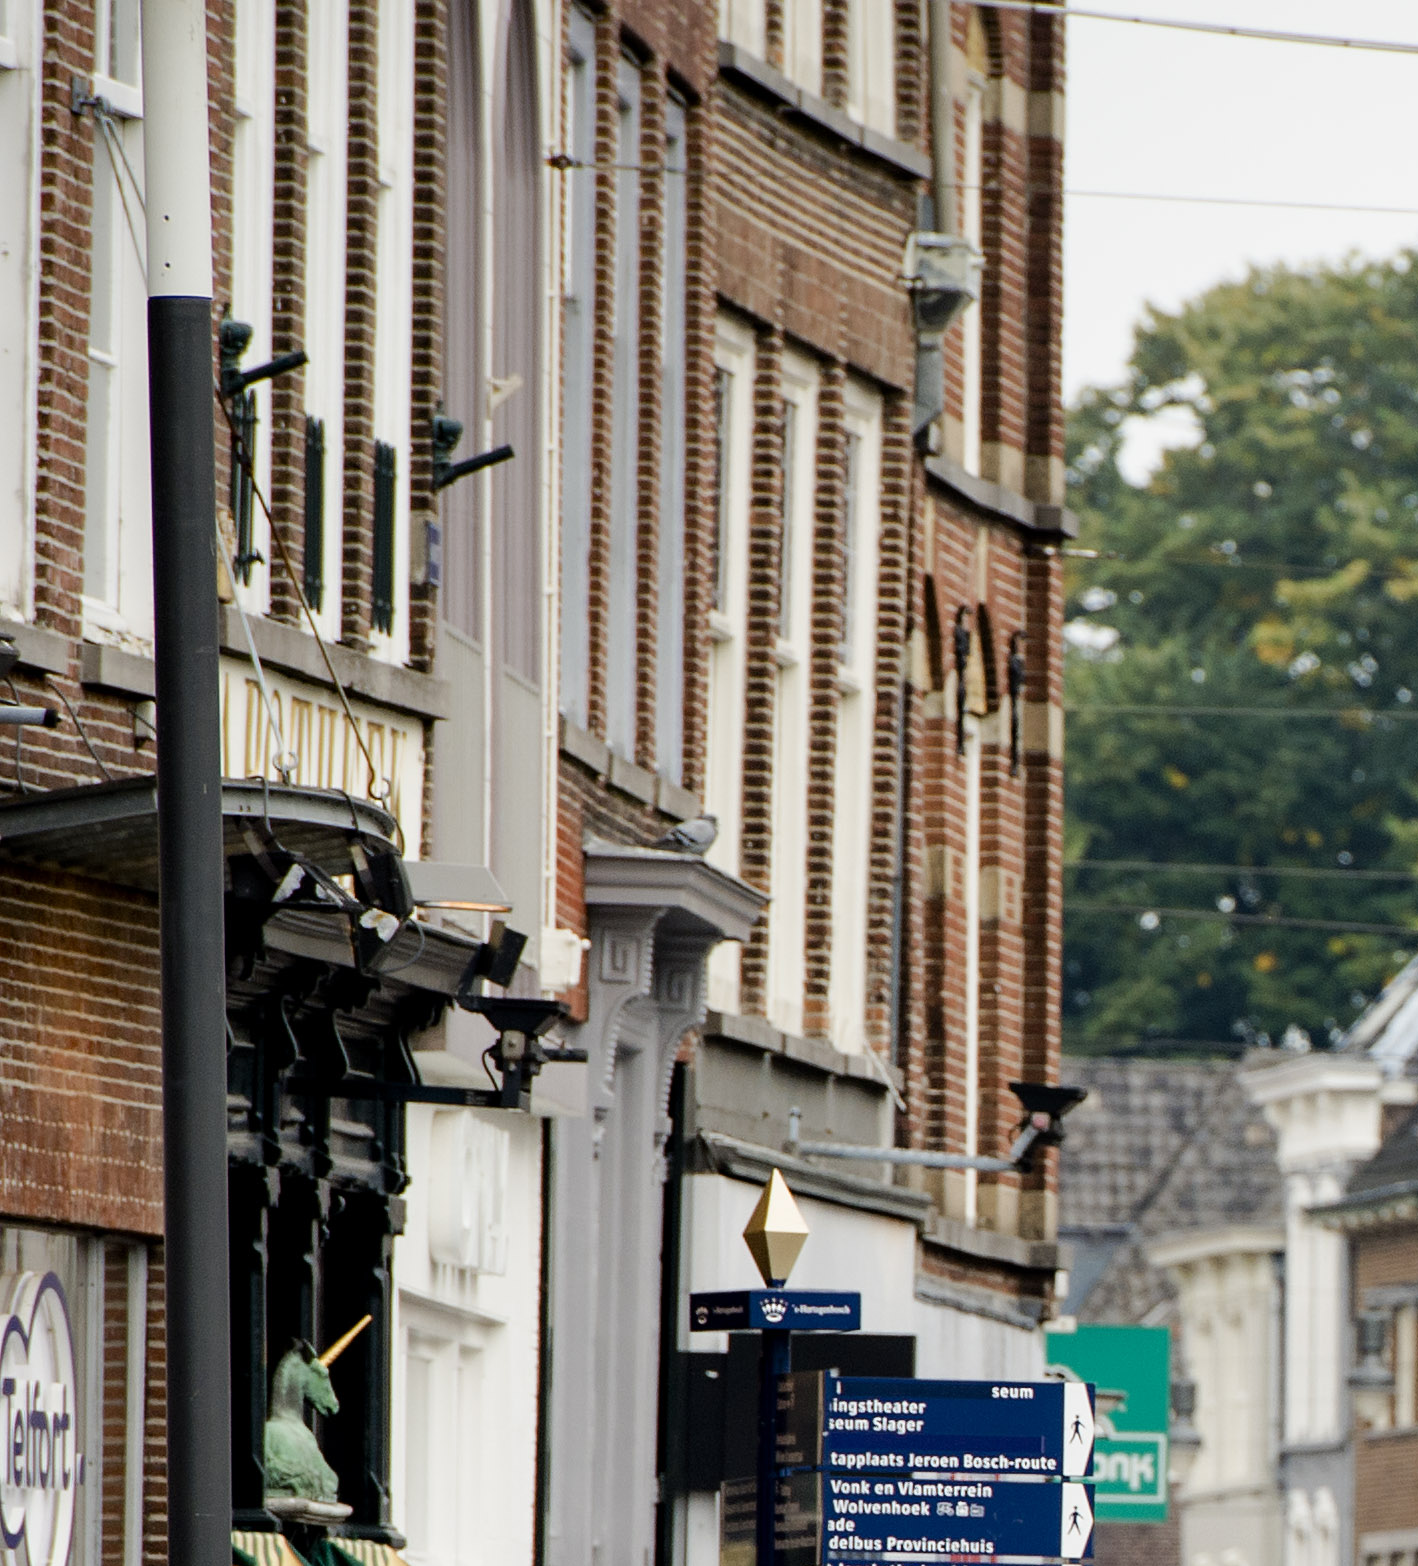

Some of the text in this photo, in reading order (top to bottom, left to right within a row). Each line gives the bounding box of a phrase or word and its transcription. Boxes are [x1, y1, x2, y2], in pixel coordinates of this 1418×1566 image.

[991, 1385, 1034, 1399] seum
[872, 1416, 924, 1434] Slager
[830, 1451, 1057, 1471] tapplaats Jeroen Bosch-route
[830, 1479, 992, 1498] Vonk en Vlamterrein
[833, 1499, 930, 1516] Wolvenhoek
[827, 1517, 856, 1532] ade
[828, 1535, 995, 1553] delbus Provinciehuis
